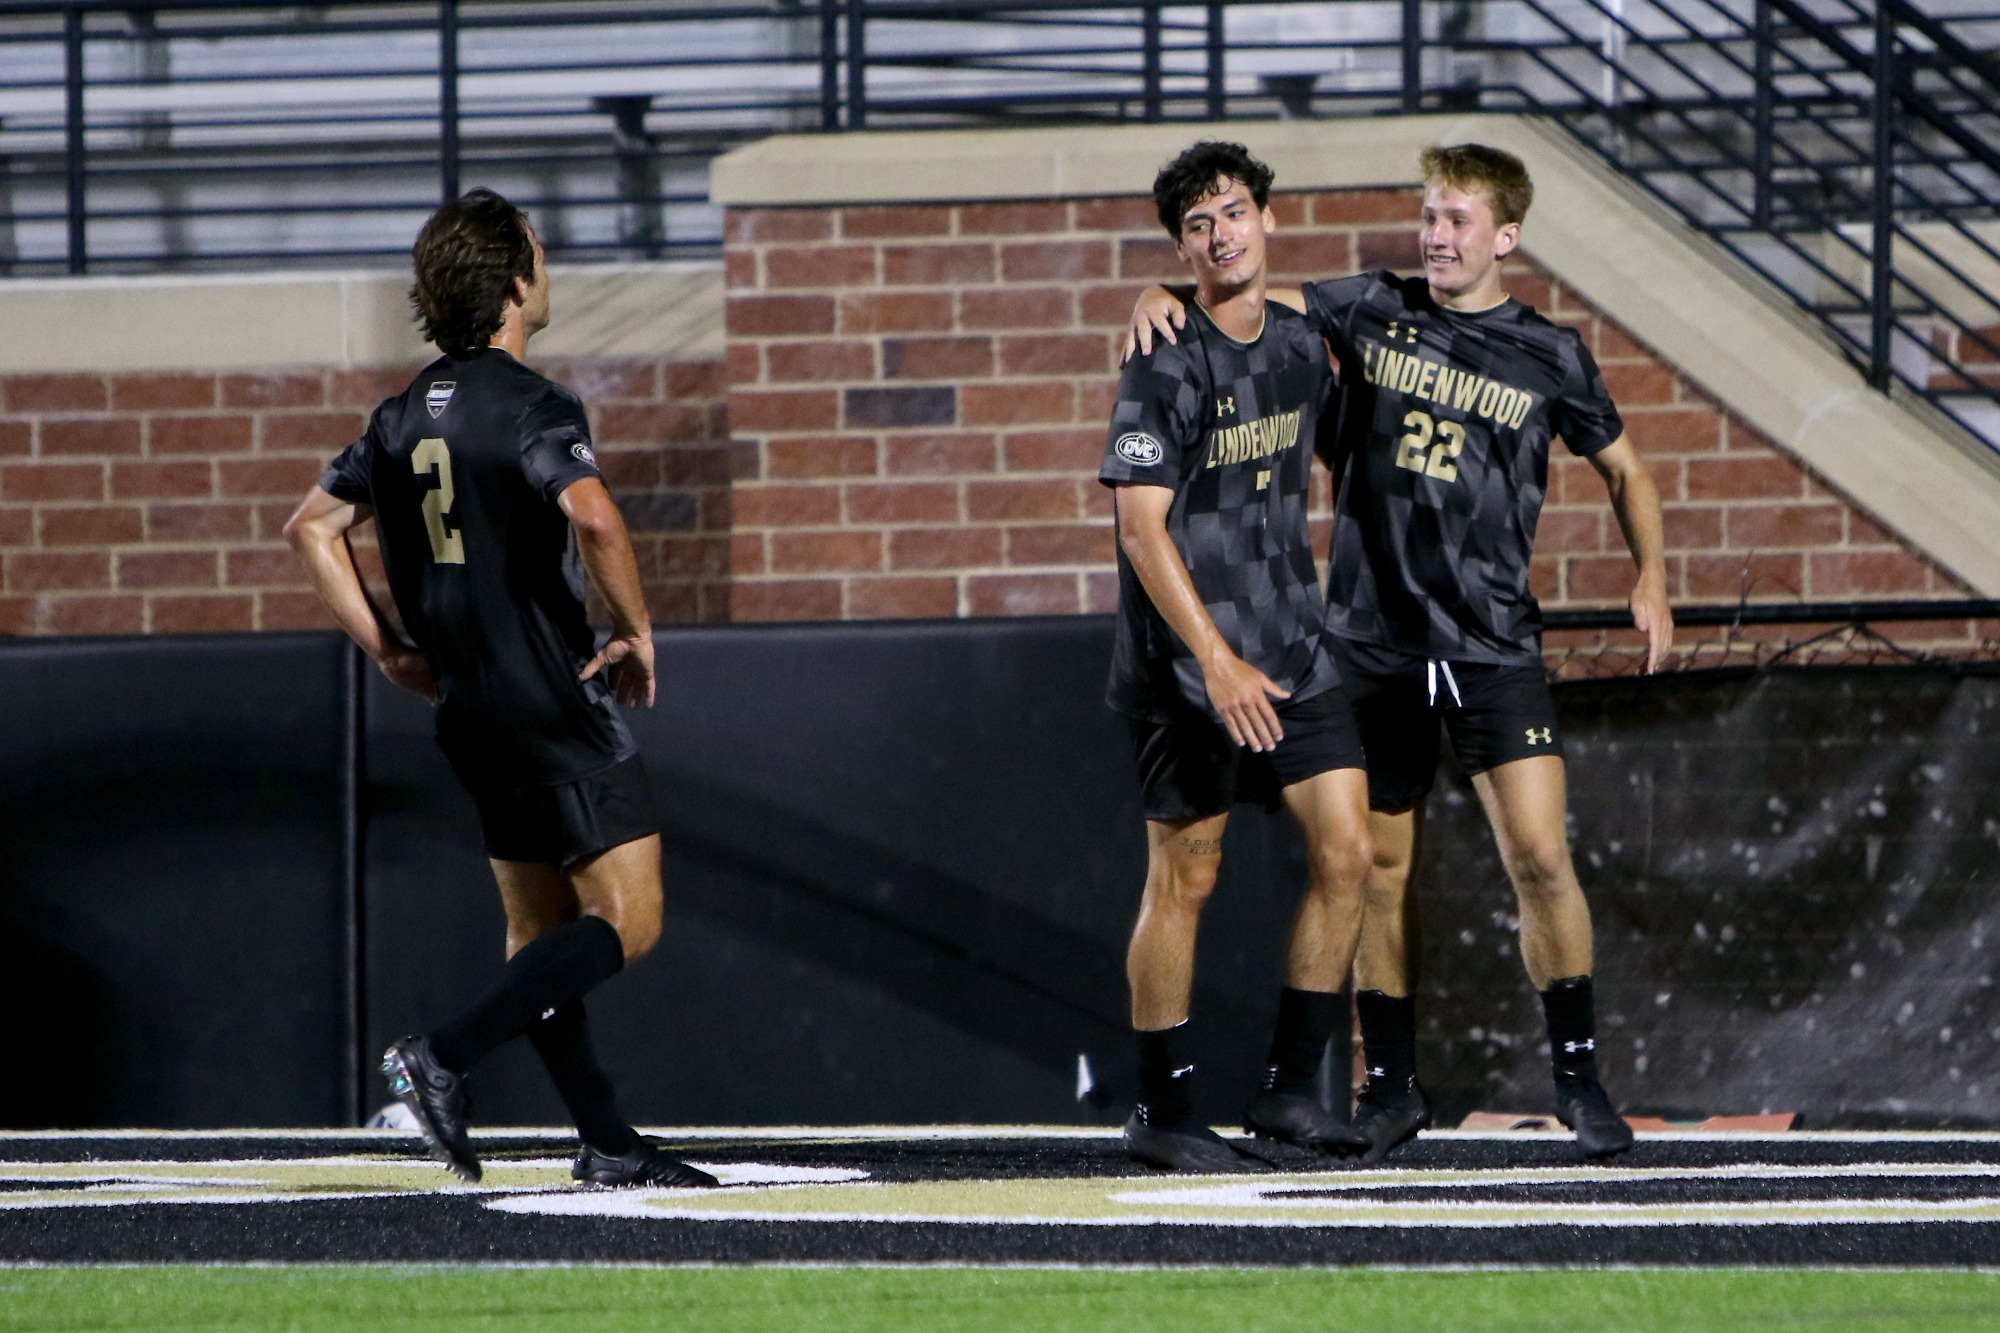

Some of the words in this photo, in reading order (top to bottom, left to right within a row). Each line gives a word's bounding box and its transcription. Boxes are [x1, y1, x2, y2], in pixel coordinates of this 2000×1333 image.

[1364, 343, 1533, 431] LINDENWOOD
[1123, 440, 1154, 459] OVC
[1395, 410, 1466, 483] 22
[411, 438, 465, 564] 2
